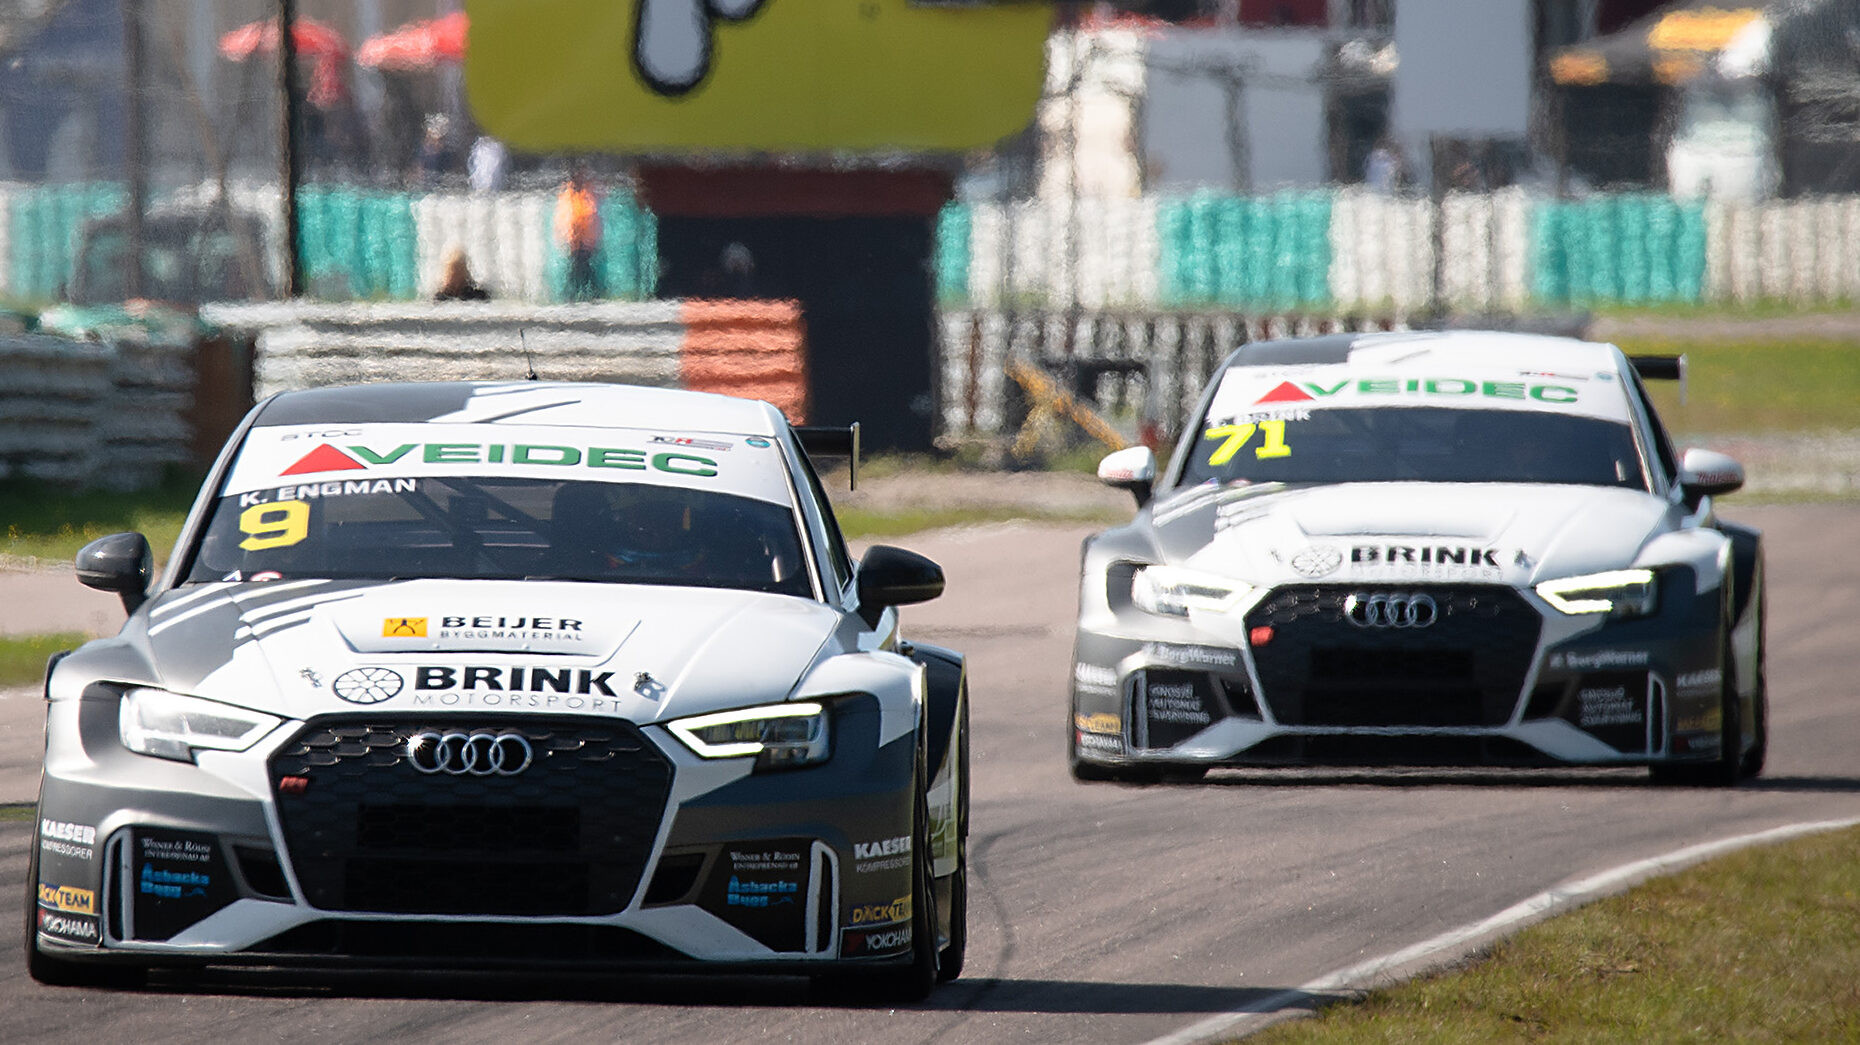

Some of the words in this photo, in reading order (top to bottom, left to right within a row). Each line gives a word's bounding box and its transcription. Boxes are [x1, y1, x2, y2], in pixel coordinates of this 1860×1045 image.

[1302, 379, 1578, 403] VEIDEC
[1204, 420, 1292, 466] 71
[346, 443, 718, 477] VEIDEC
[240, 491, 269, 507] K.
[277, 479, 416, 501] ENGMAN
[239, 500, 311, 551] 9
[1351, 546, 1500, 567] BRINK
[439, 630, 583, 641] BYGGMATERIAL
[441, 616, 583, 631] BEIJER
[414, 666, 617, 697] BRINK
[413, 693, 622, 712] MOTORSPORT
[60, 891, 90, 909] TEAM
